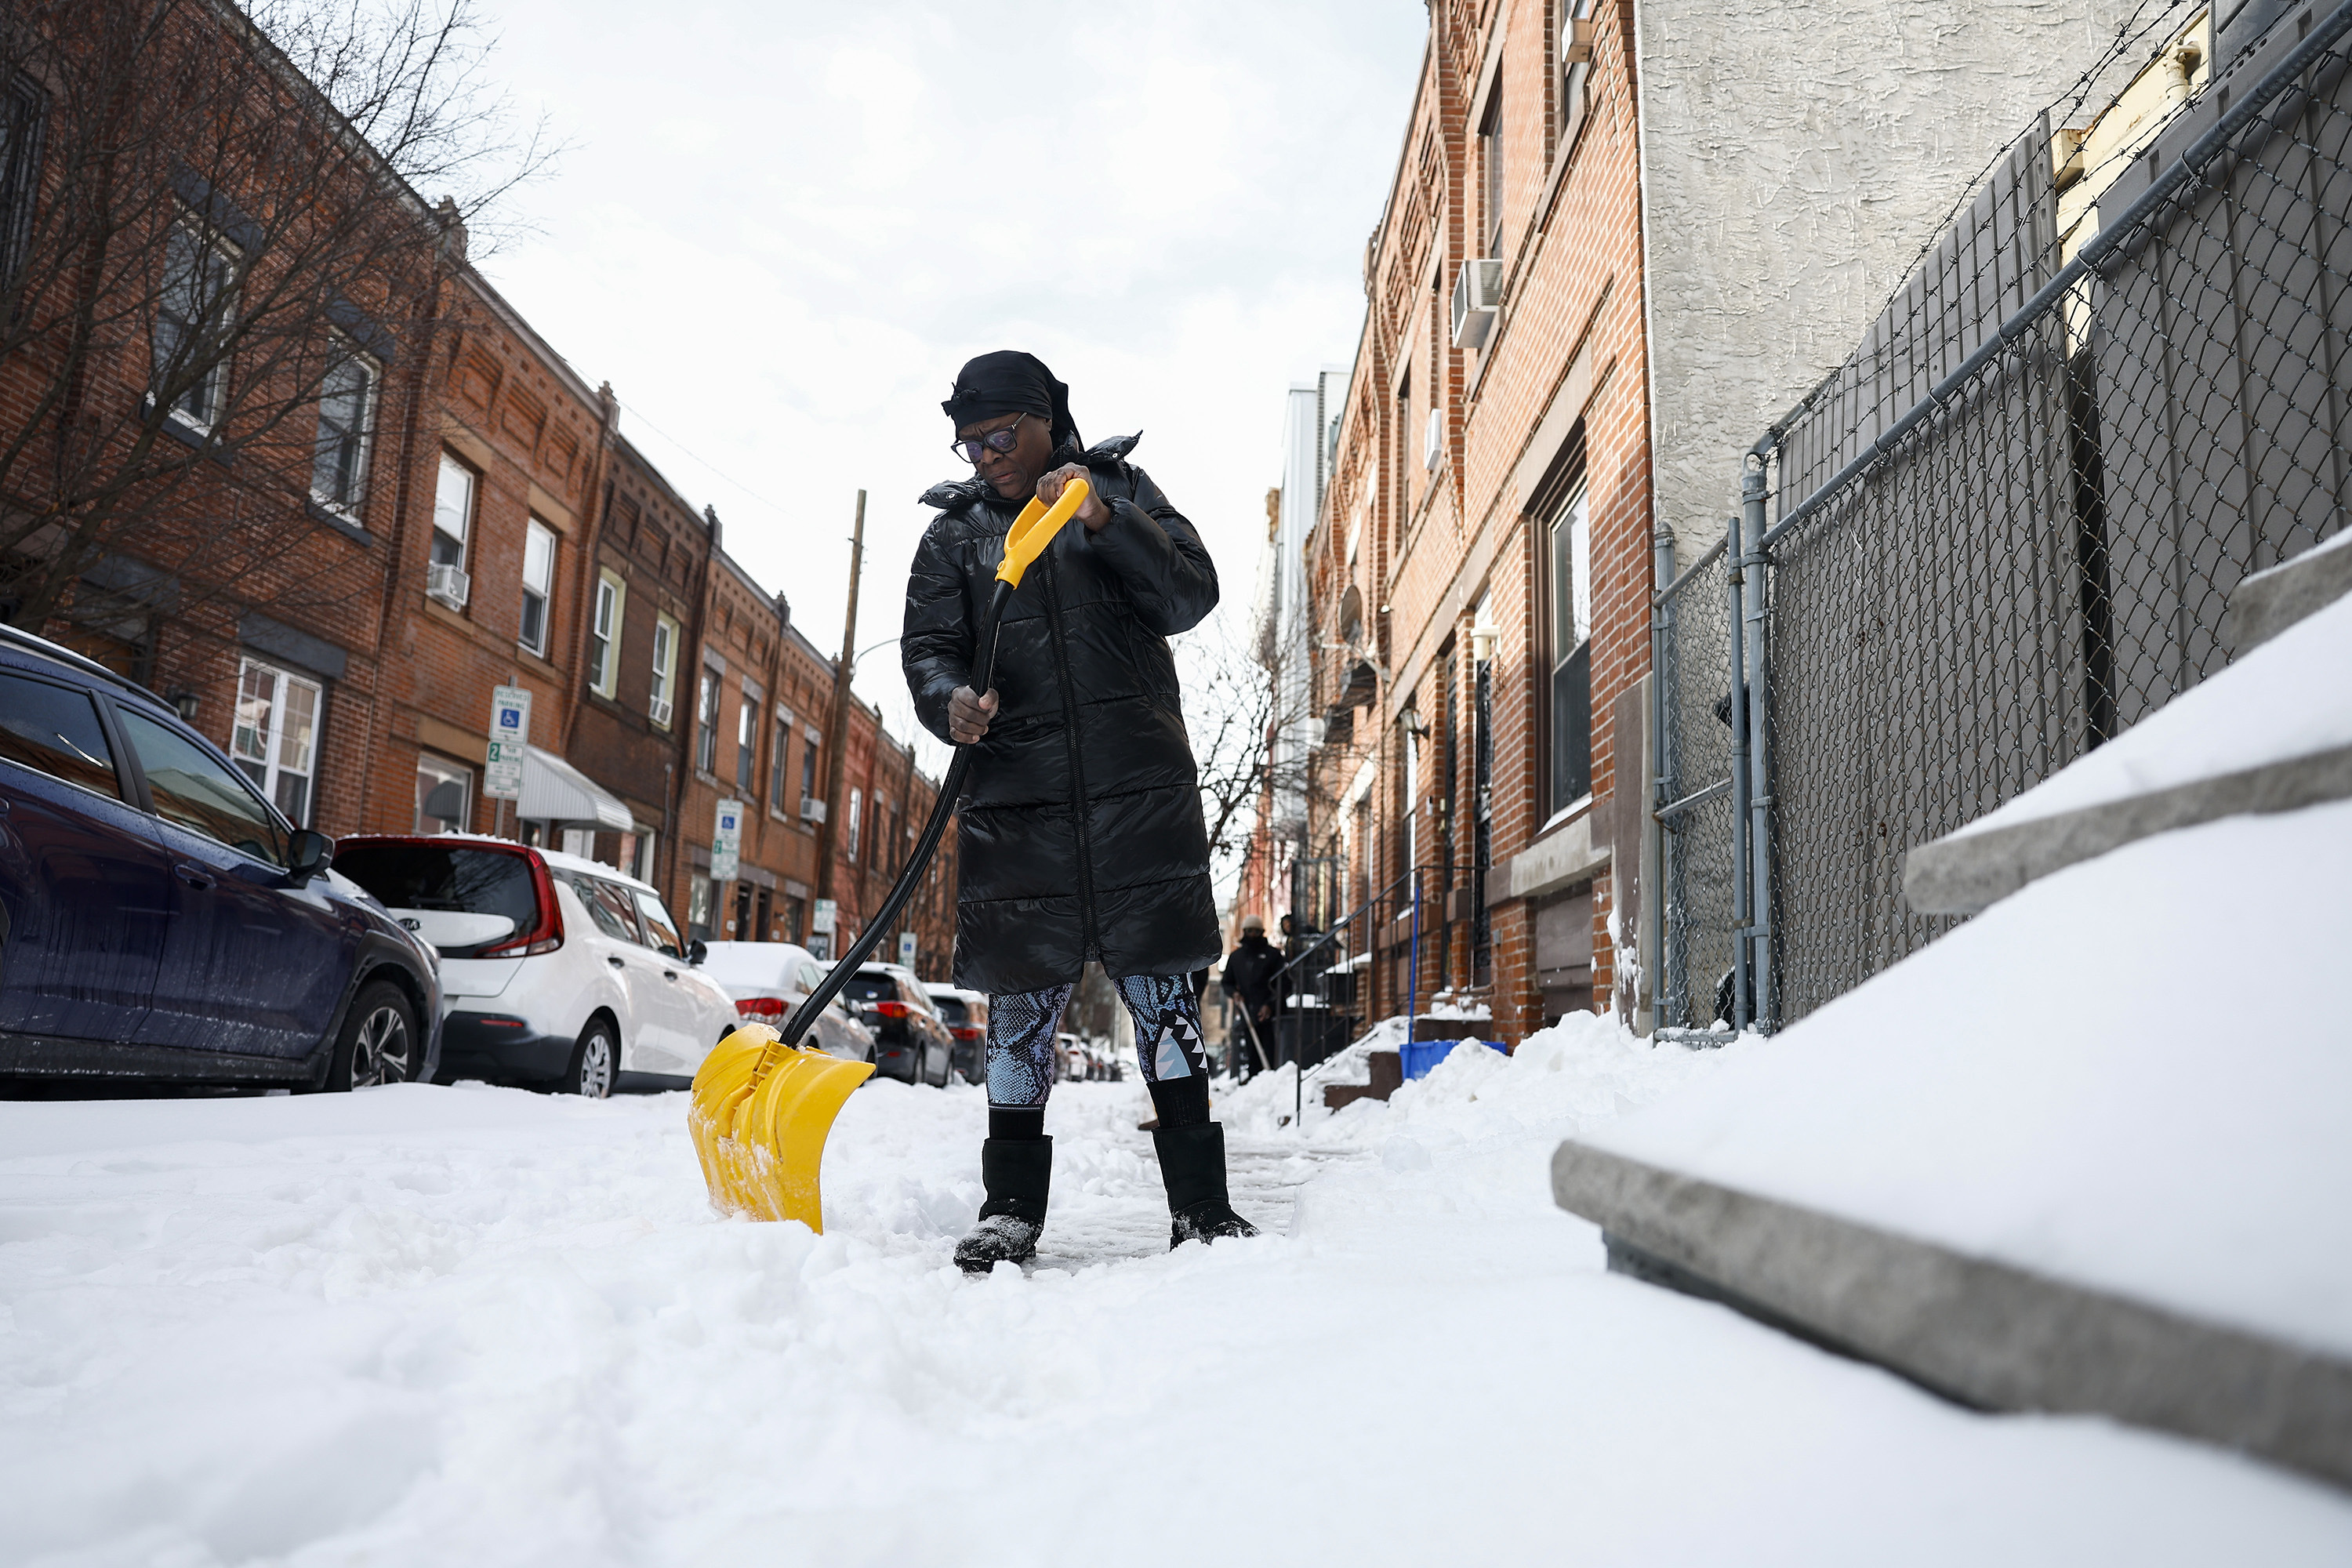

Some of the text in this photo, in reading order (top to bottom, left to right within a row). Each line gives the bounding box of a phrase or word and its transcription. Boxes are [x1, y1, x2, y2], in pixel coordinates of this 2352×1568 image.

[496, 690, 527, 701] RESERVED
[498, 700, 524, 710] PARKING
[490, 744, 499, 760] 2
[499, 754, 521, 763] PARKING
